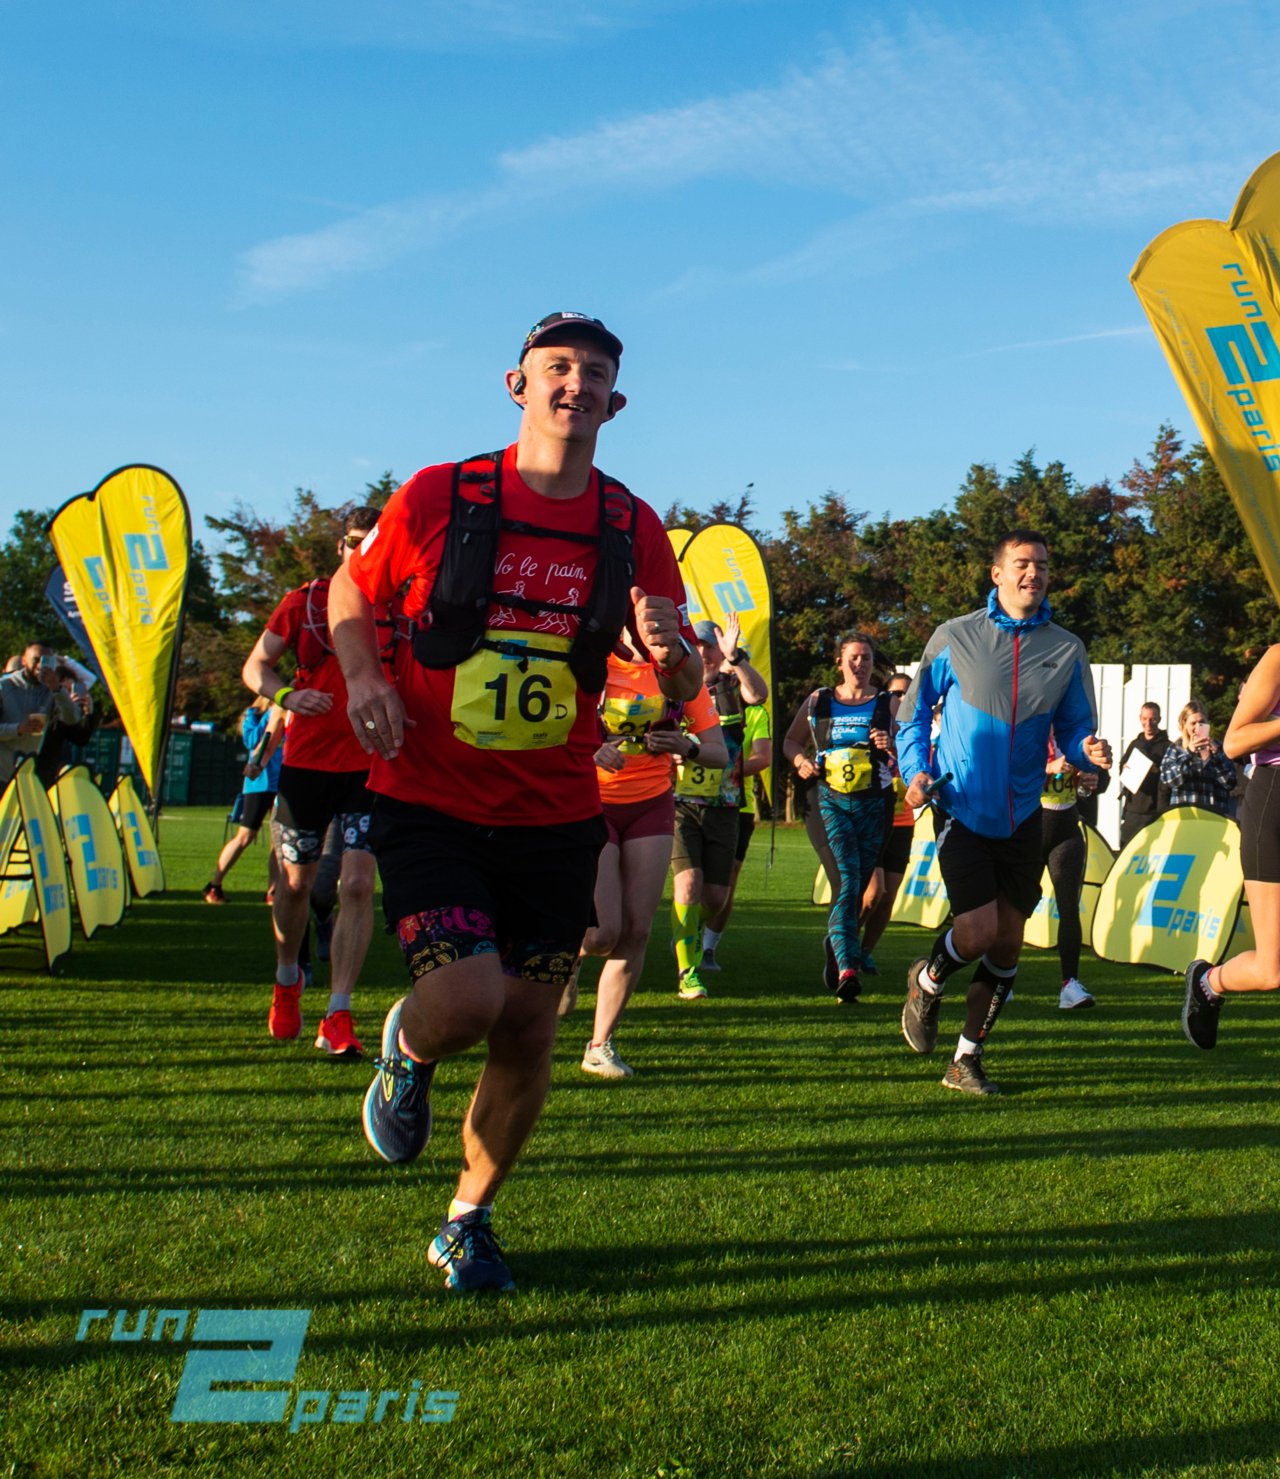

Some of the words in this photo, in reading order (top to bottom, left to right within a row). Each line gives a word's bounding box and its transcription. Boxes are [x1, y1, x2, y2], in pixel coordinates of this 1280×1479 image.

[1221, 262, 1263, 318] run
[520, 555, 539, 577] le
[484, 672, 553, 723] 16
[691, 765, 705, 785] 3
[842, 763, 856, 782] 8
[1126, 854, 1162, 876] run
[1167, 907, 1221, 939] paris
